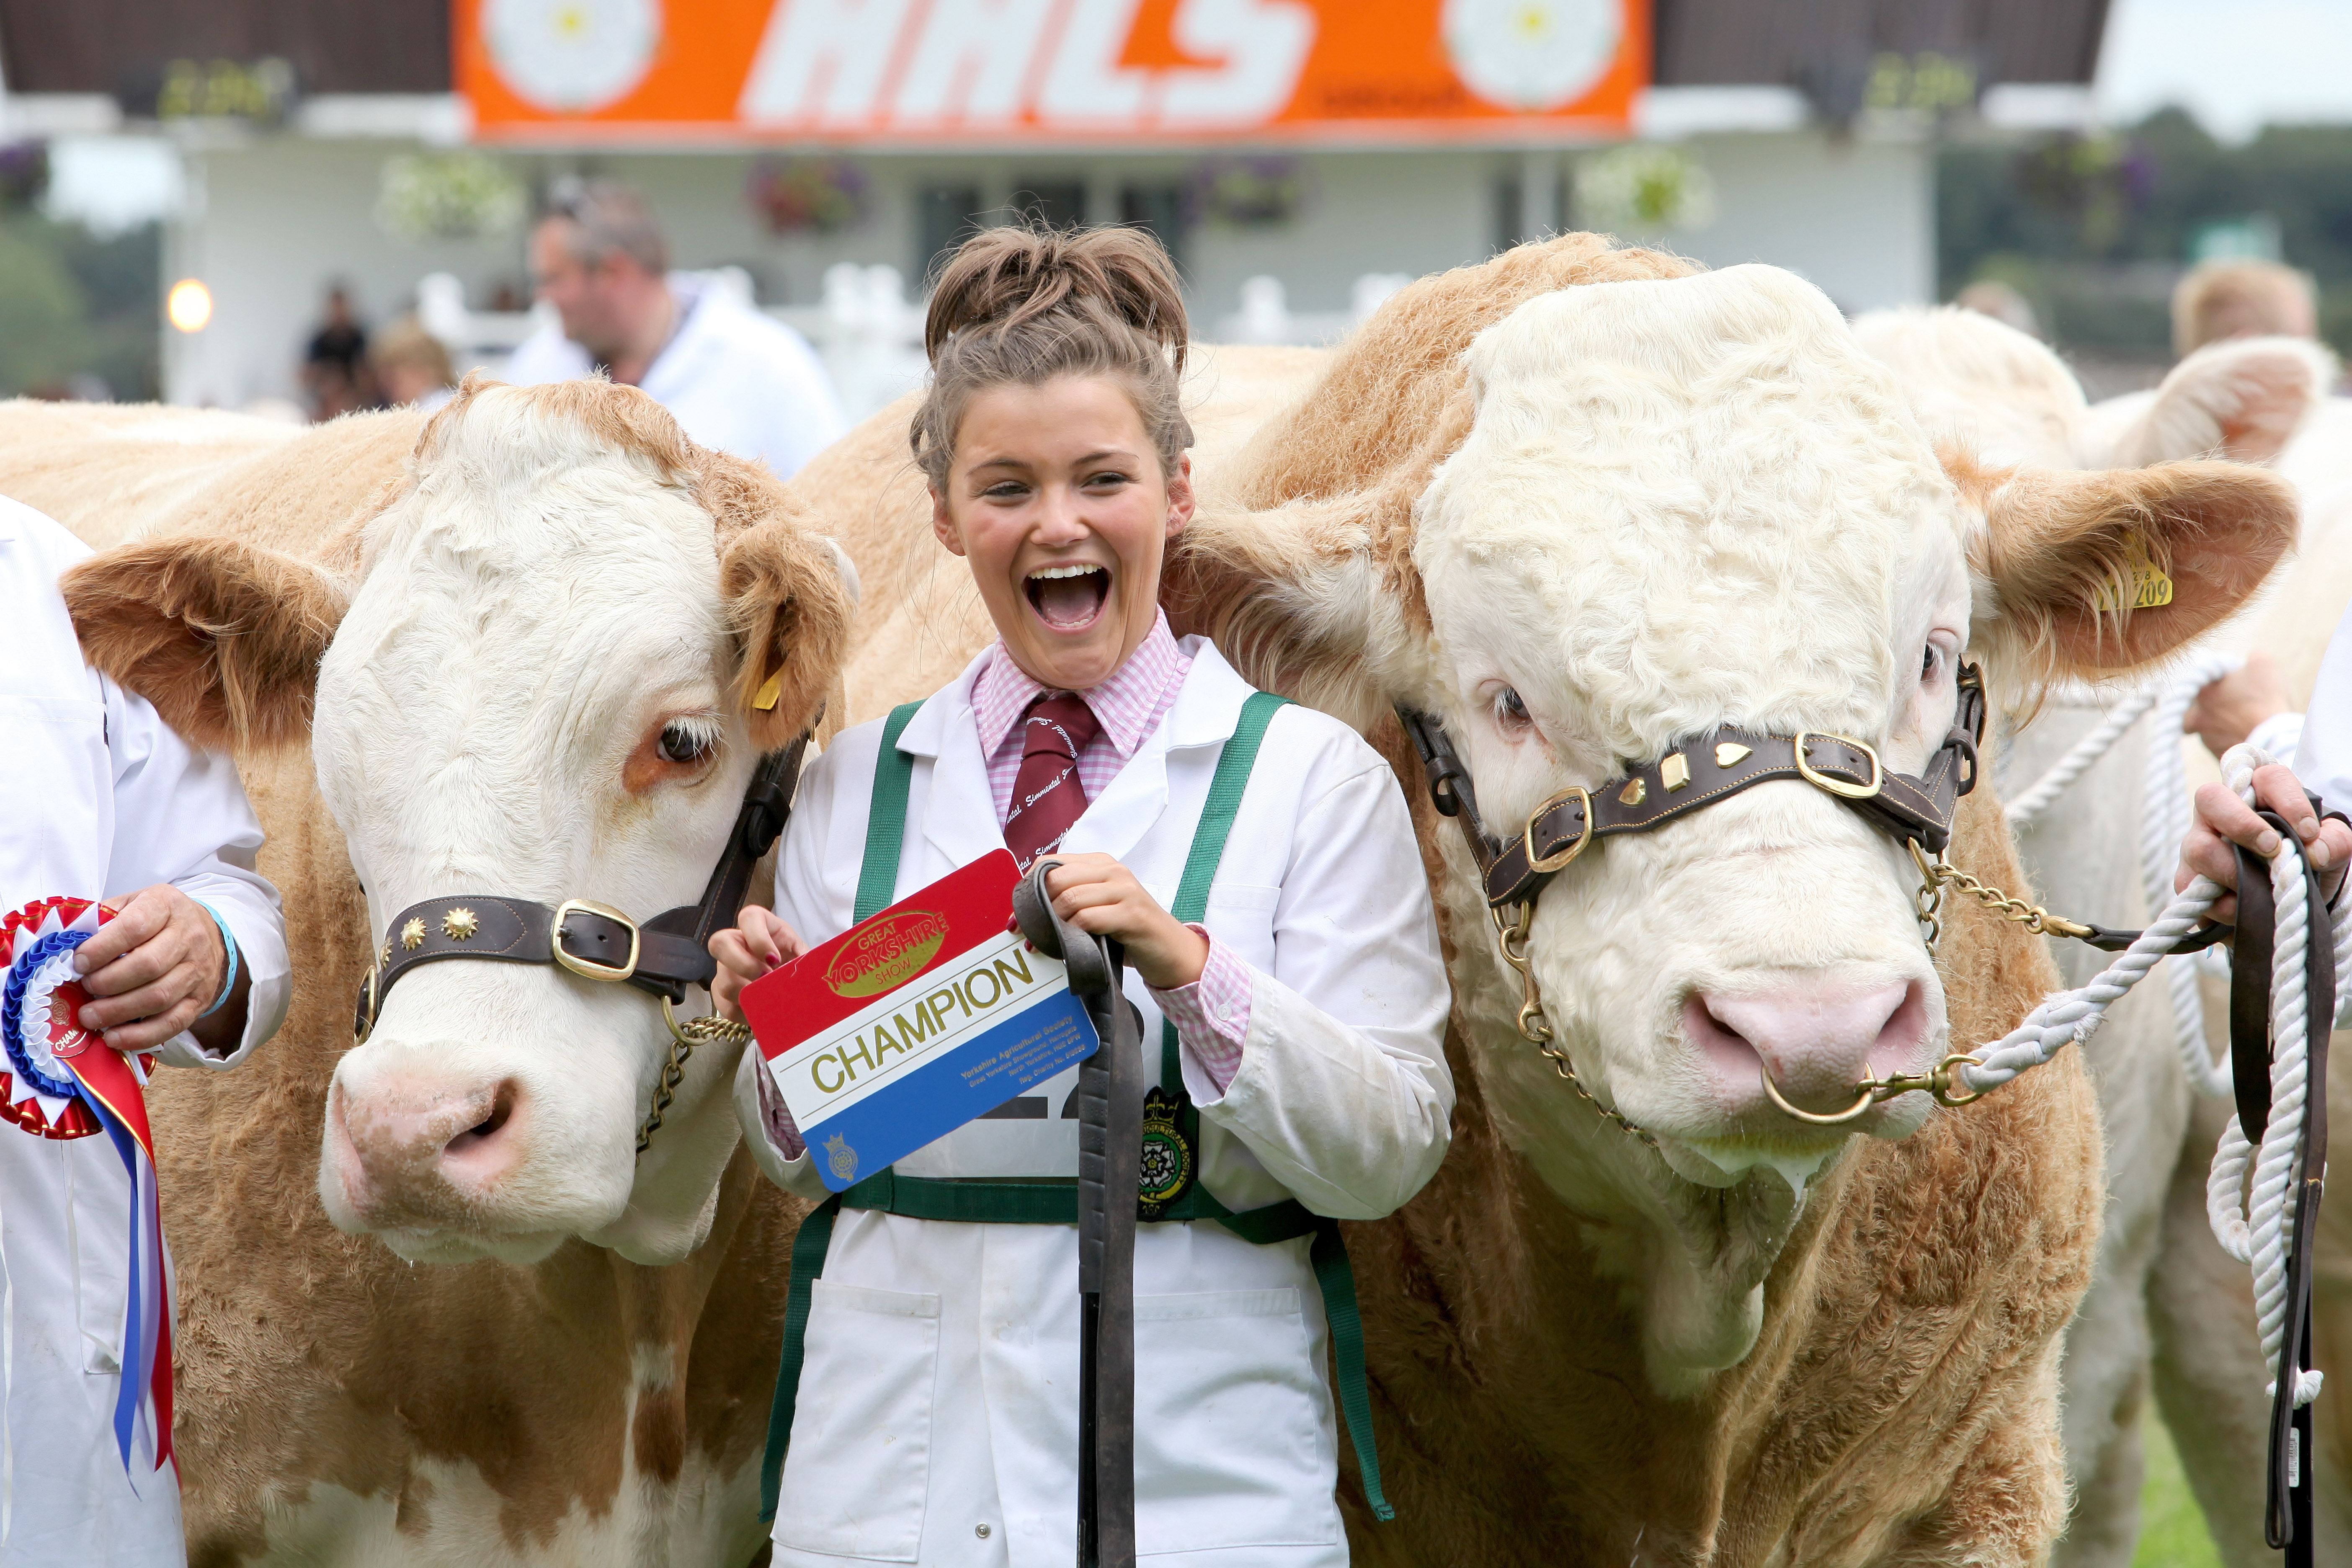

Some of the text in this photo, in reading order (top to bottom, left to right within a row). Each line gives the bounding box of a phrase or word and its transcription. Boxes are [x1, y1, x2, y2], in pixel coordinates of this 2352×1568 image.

[1052, 725, 1078, 758] Simmental
[1026, 776, 1061, 807] Simmental
[859, 921, 896, 950] GREAT
[822, 912, 949, 991] YORKSHIRE
[875, 957, 910, 984] SHOW
[811, 948, 1034, 1093] CHAMPION
[55, 1026, 80, 1052] CHAM
[961, 1016, 1073, 1079] Yorkshire Agricultural Society
[970, 1076, 986, 1087] Great
[986, 1062, 1012, 1078] Yorkshire
[1049, 1026, 1077, 1044] Harrogate
[1008, 1065, 1025, 1076] North
[1034, 1063, 1054, 1076] Charity
